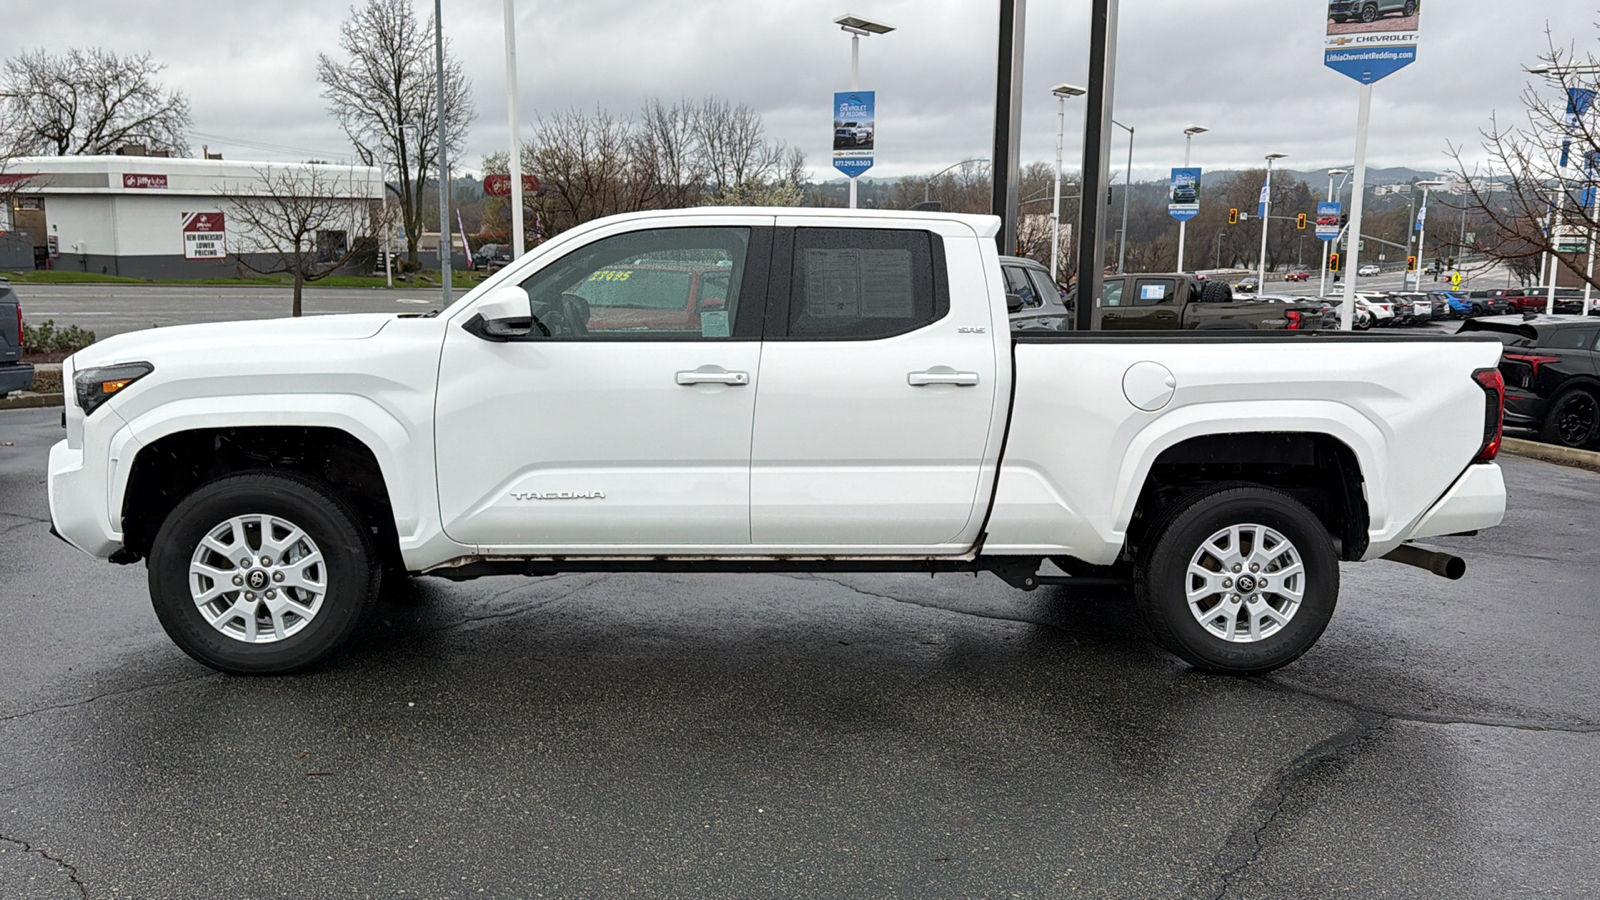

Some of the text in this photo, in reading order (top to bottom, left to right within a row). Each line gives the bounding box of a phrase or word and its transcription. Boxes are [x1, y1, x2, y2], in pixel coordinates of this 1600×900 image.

[1356, 34, 1415, 43] CHEVROLET
[1326, 51, 1413, 62] LithiaChevroletRedding.com
[186, 233, 223, 241] NEW OWNERSHIP
[510, 490, 606, 501] TACOMA
